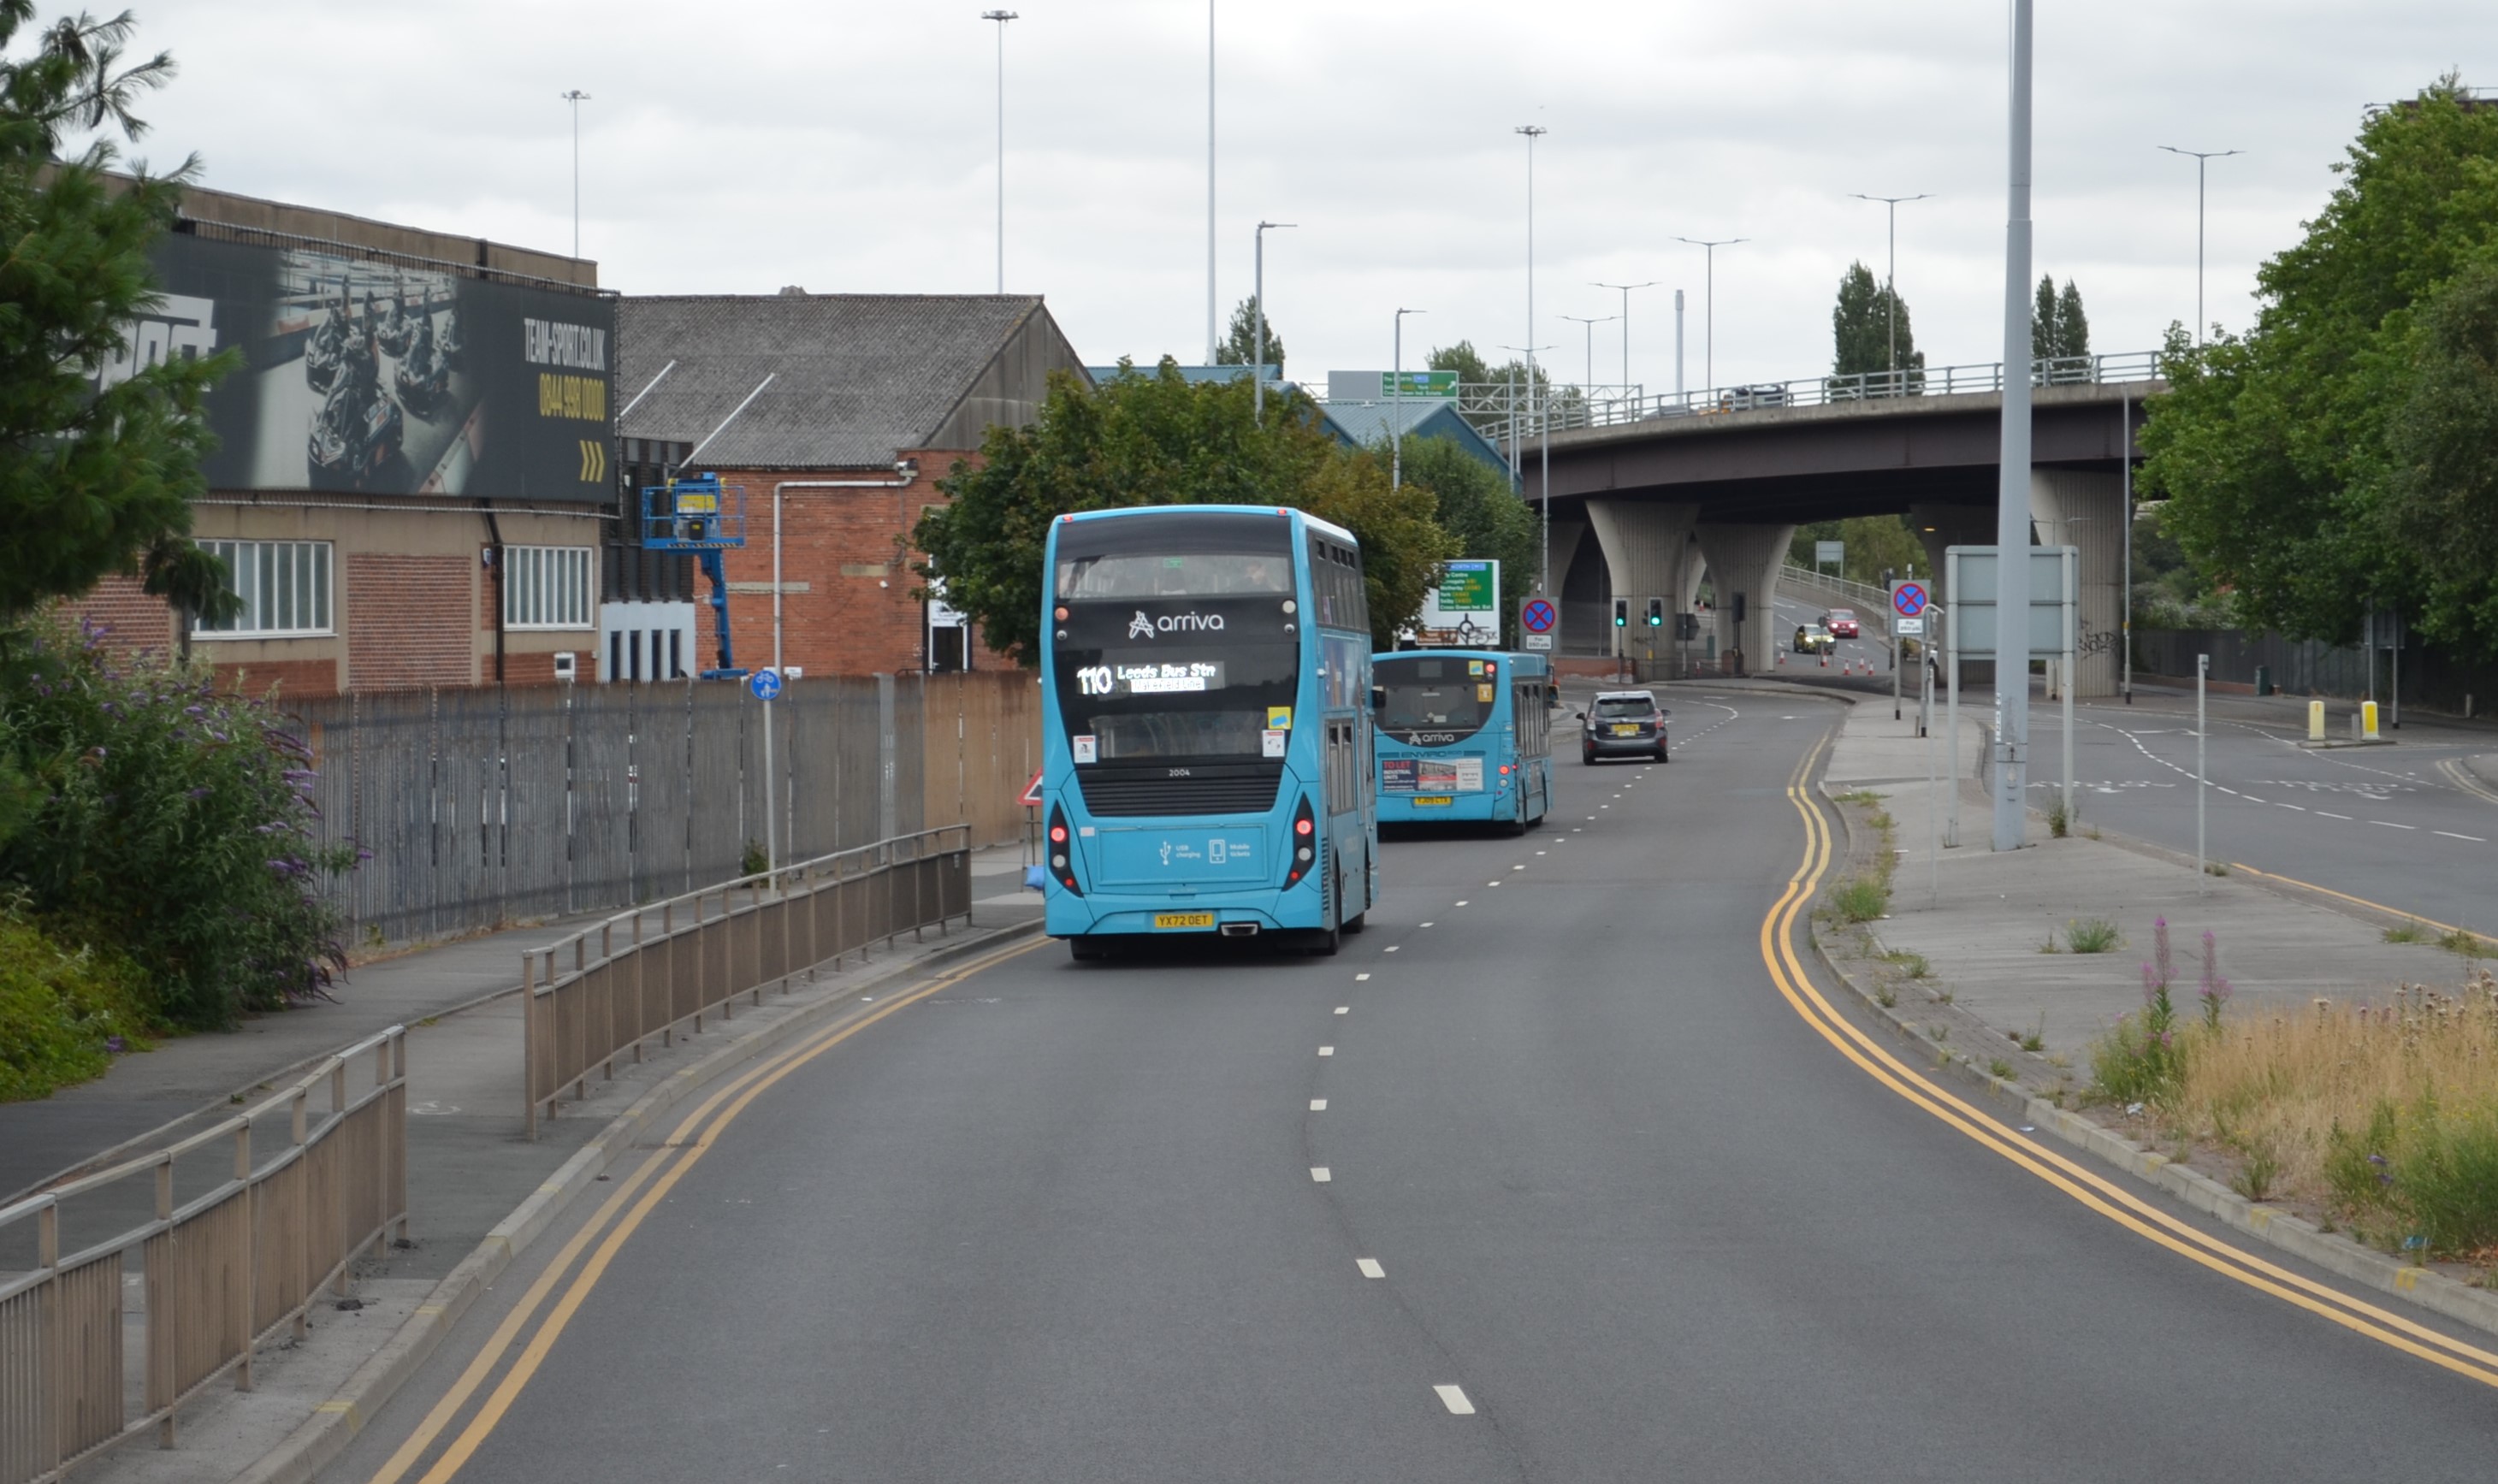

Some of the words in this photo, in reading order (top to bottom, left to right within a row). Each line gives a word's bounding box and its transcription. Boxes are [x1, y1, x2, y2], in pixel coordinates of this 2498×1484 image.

[524, 317, 606, 371] TEAM-SPORT.CO.UK
[540, 372, 563, 417] 0844
[564, 375, 581, 419] 998
[583, 377, 605, 421] 0000
[1157, 611, 1224, 632] arriva
[1077, 665, 1112, 695] 110
[1117, 665, 1157, 680] Leeds
[1161, 664, 1187, 678] Bus
[1190, 663, 1216, 677] Stn
[1422, 733, 1454, 742] arriva
[1383, 760, 1394, 769] TO
[1396, 760, 1411, 769] LET
[1159, 915, 1186, 925] YX72
[1187, 914, 1208, 925] OET
